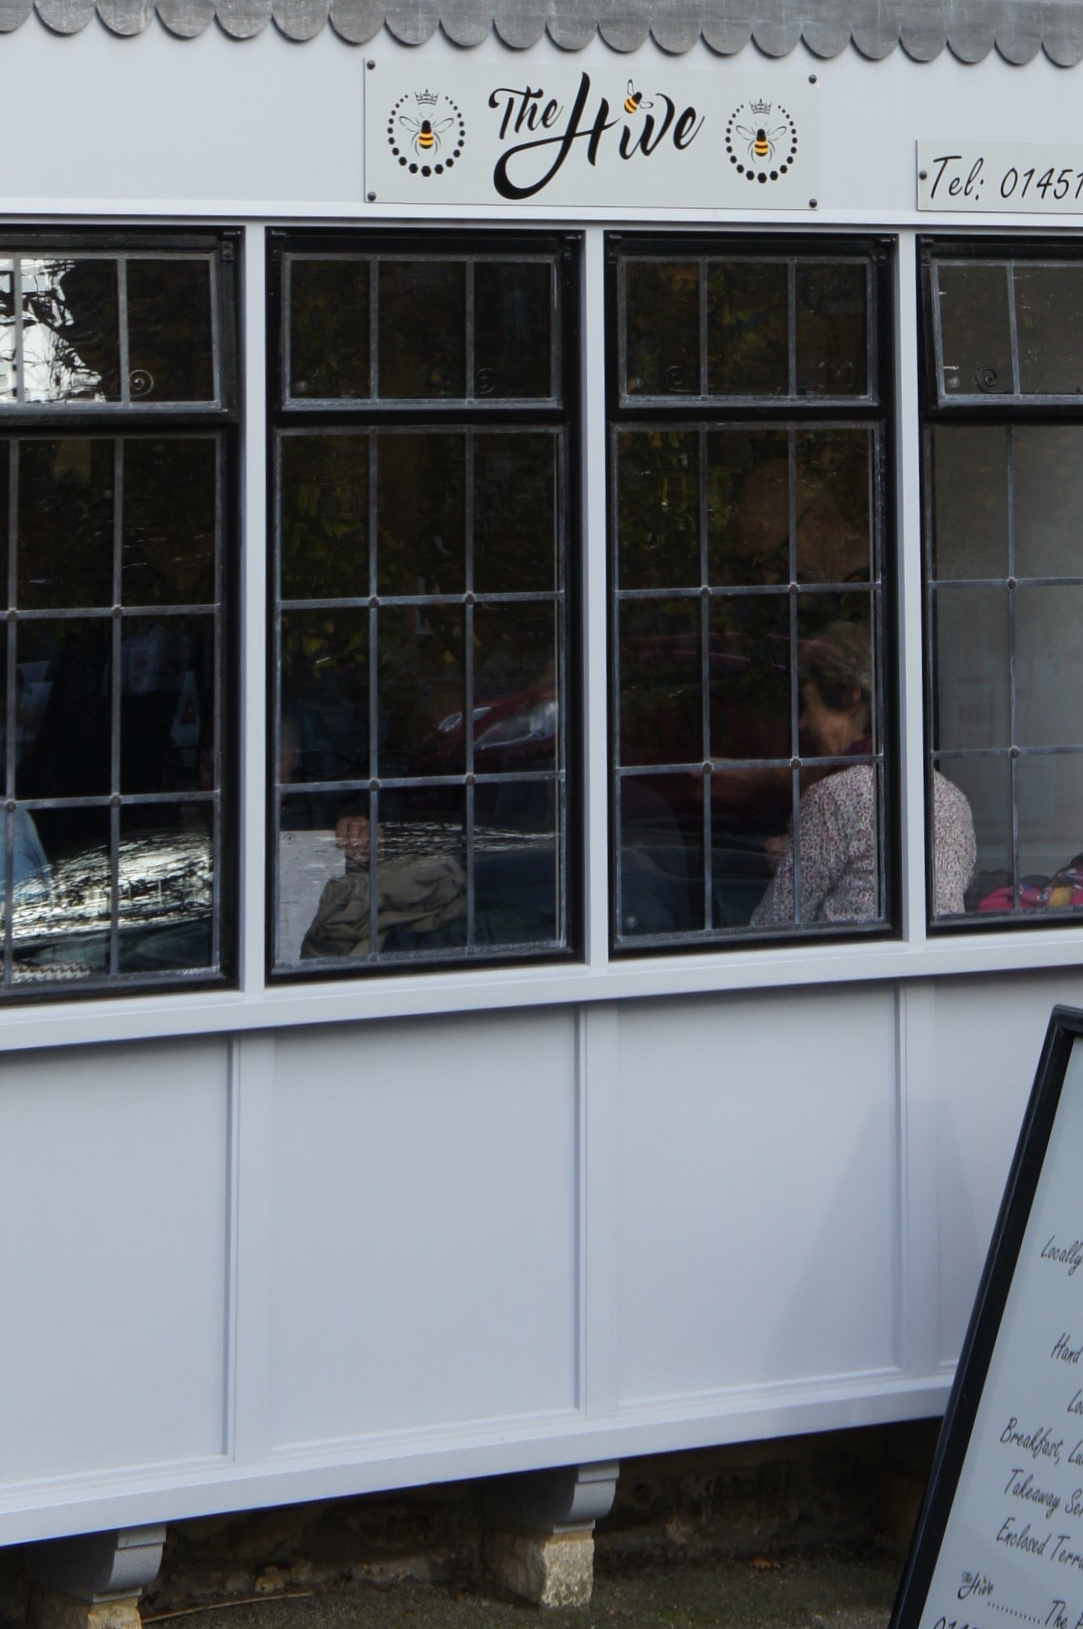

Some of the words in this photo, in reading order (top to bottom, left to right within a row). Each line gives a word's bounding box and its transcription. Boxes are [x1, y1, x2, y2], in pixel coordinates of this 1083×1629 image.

[488, 85, 565, 140] The
[493, 71, 706, 200] Hive
[930, 155, 985, 201] Tel:
[1040, 1235, 1083, 1276] Locally
[1050, 1332, 1082, 1365] Hand
[999, 1417, 1063, 1465] Breakfast,
[1003, 1468, 1062, 1519] Takeaway
[995, 1517, 1052, 1556] Enclosed
[1045, 1600, 1068, 1629] The
